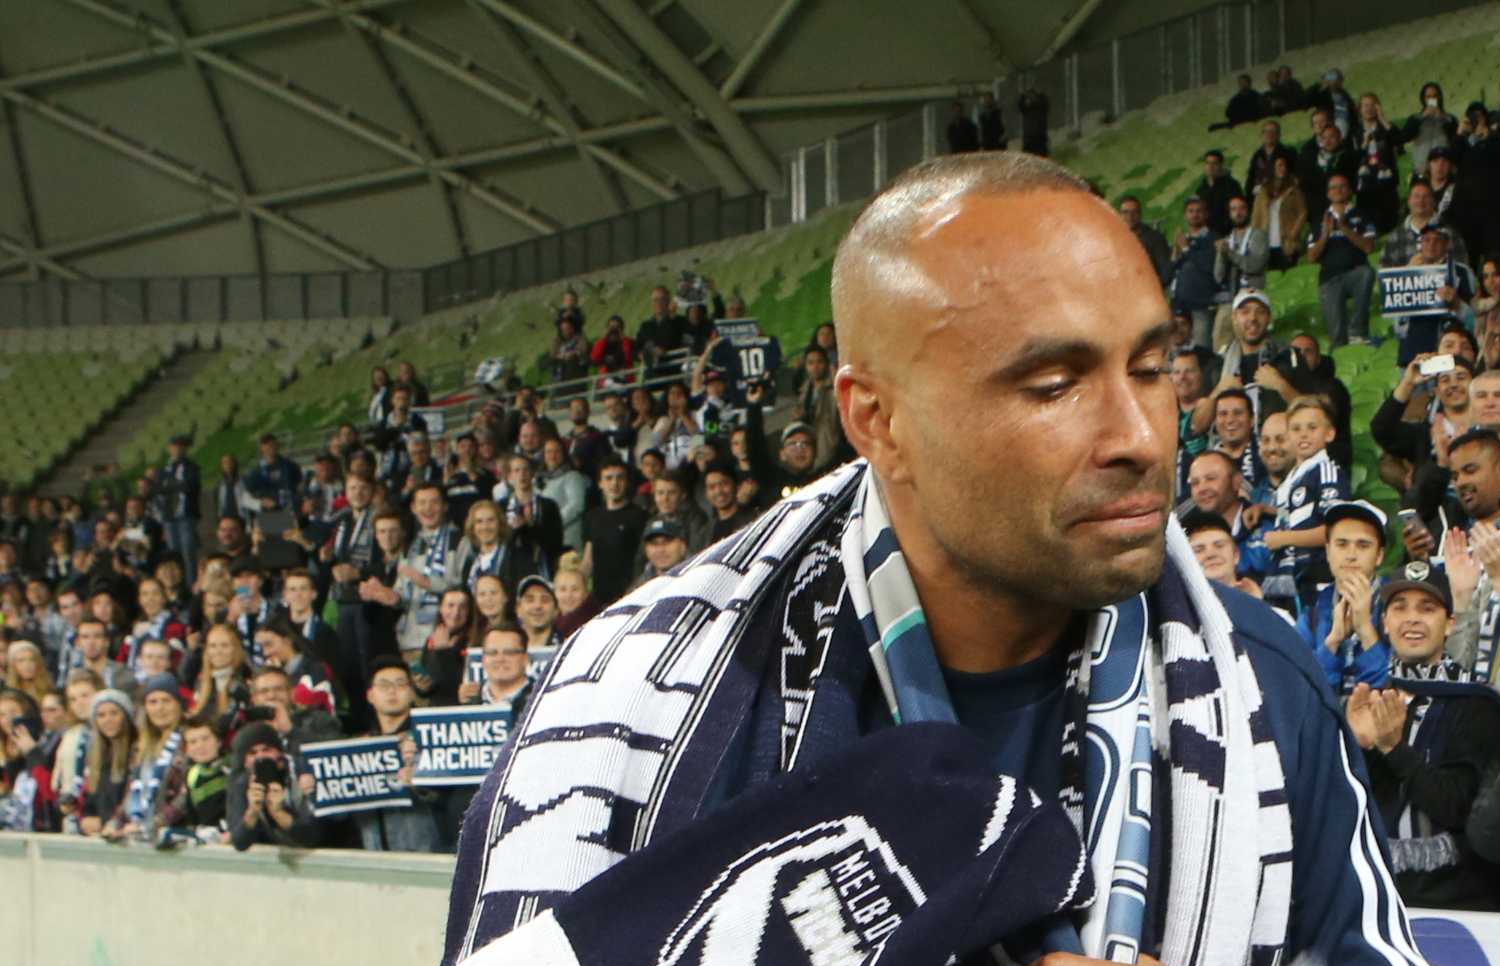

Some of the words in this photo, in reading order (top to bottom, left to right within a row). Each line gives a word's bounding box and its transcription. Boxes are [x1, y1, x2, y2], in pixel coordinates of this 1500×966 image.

[1383, 273, 1446, 292] THANKS
[1384, 290, 1435, 309] ARCHIE
[738, 348, 765, 377] 10
[415, 720, 508, 747] THANKS
[308, 750, 400, 779] THANKS
[417, 747, 494, 770] ARCHIE
[316, 773, 391, 802] ARCHIE
